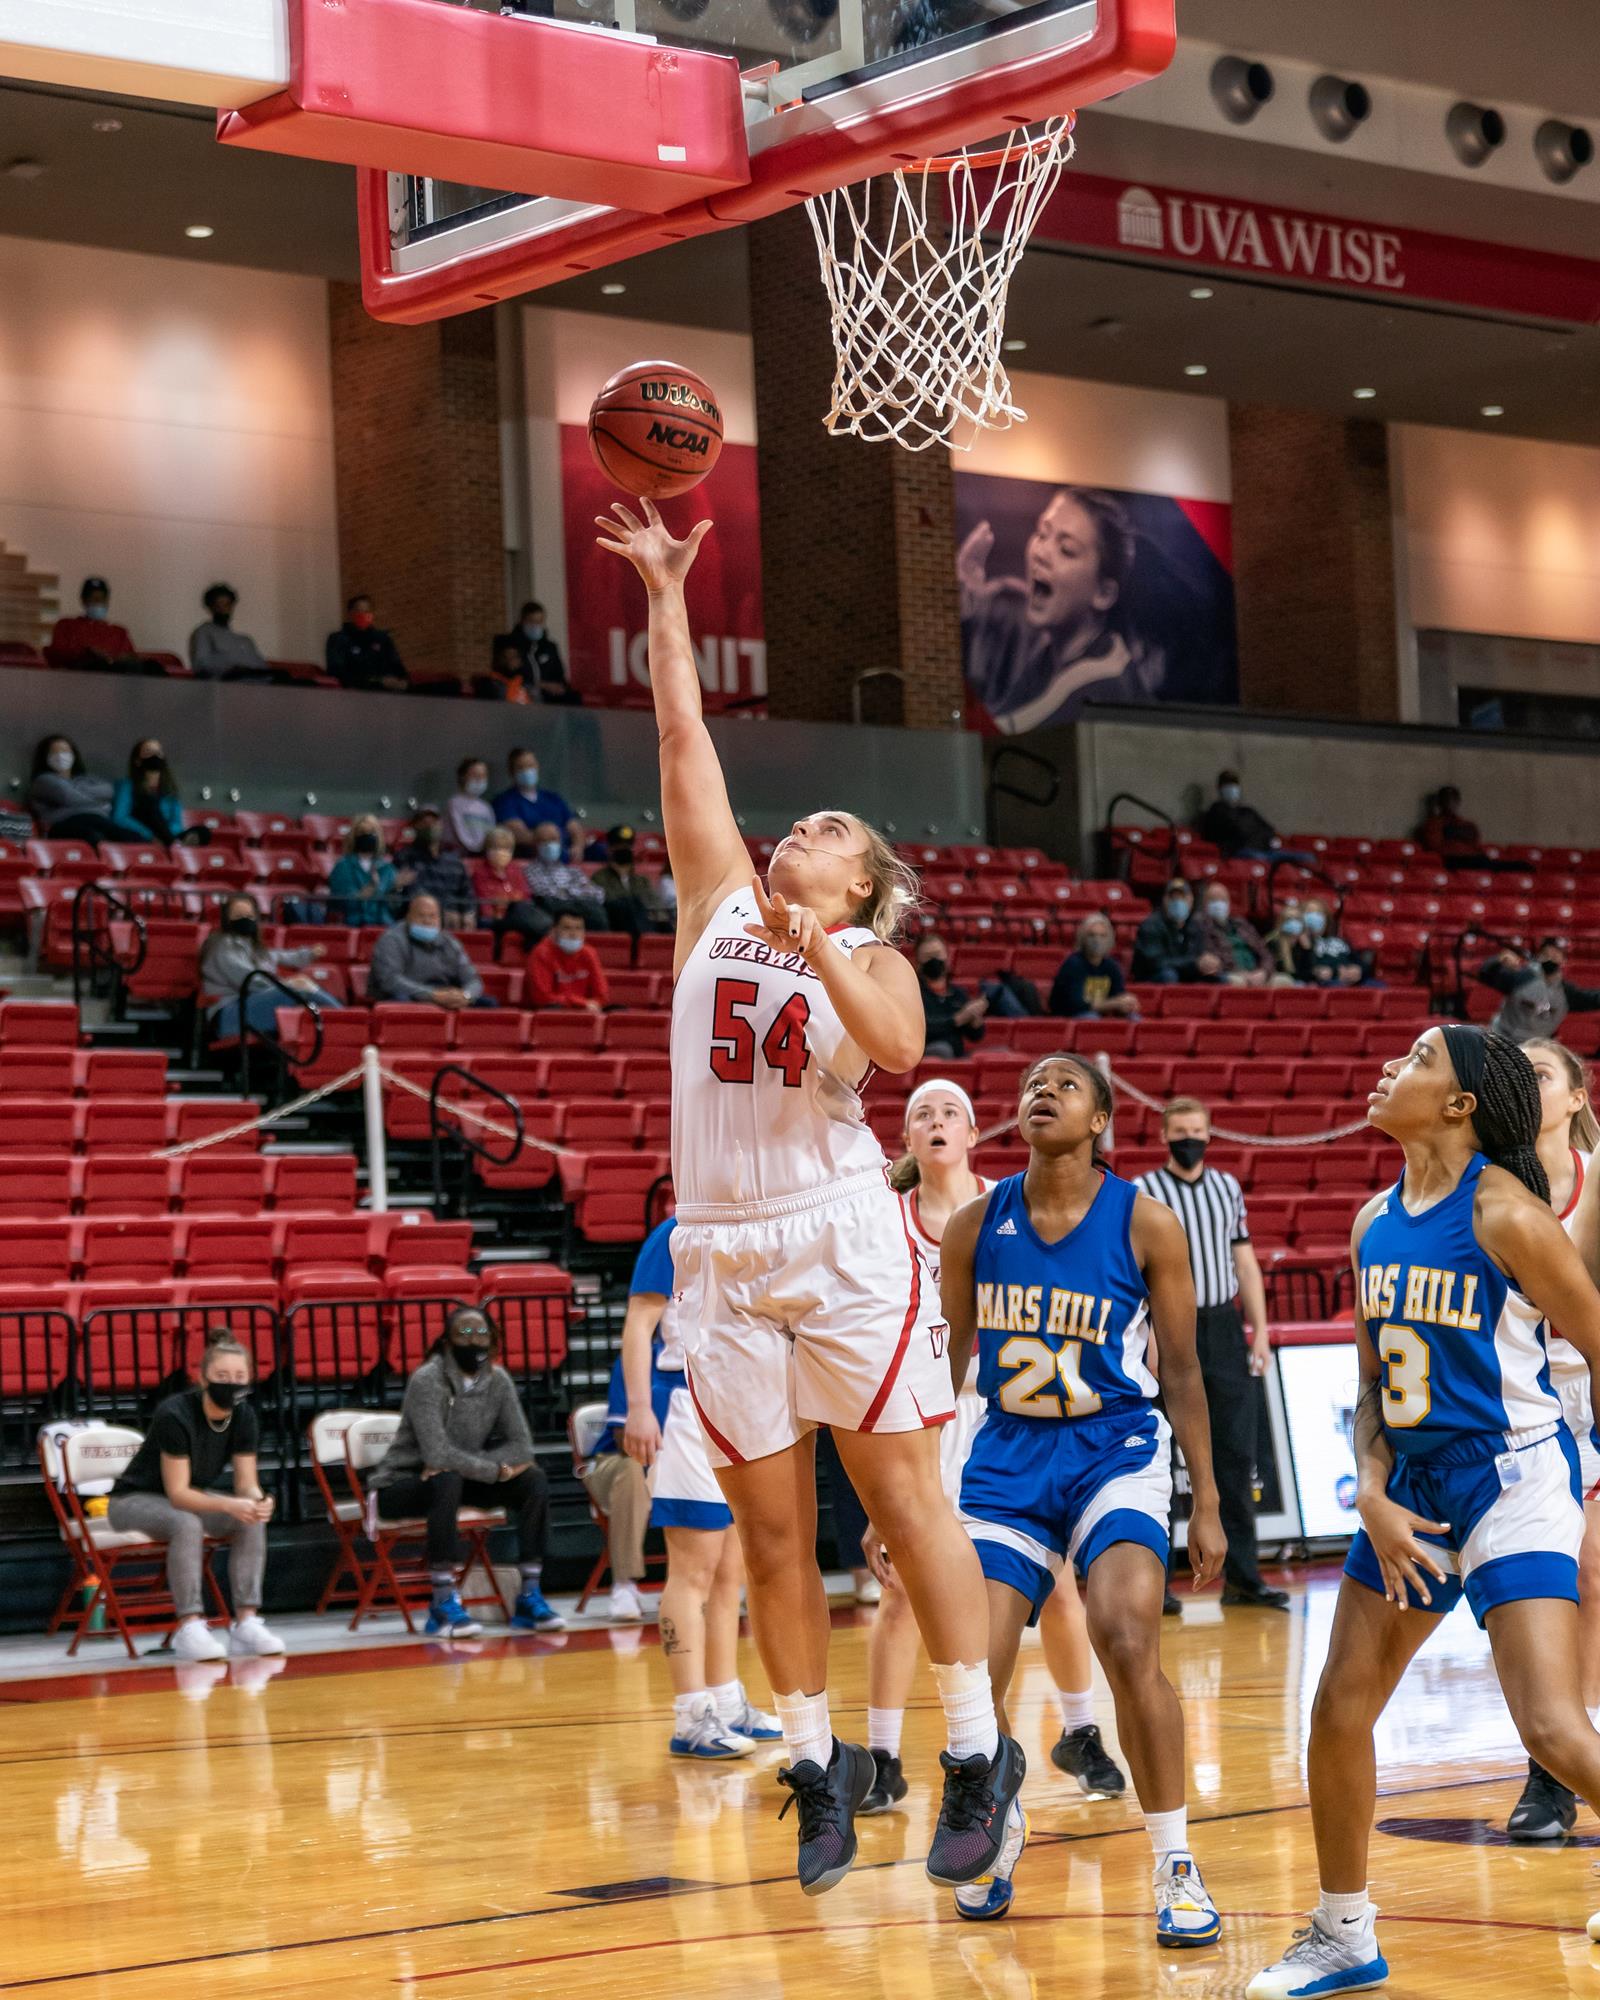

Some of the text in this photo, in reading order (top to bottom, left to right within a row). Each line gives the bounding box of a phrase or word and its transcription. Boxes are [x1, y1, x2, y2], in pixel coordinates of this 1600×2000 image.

[1167, 196, 1406, 288] UVA WISE
[640, 382, 719, 423] Wilson
[646, 421, 710, 456] NCAA
[710, 977, 811, 1088] 54
[977, 1282, 1112, 1346] MARS HILL
[1403, 1265, 1482, 1331] HILL
[998, 1336, 1103, 1418] 21
[1378, 1323, 1431, 1428] 3
